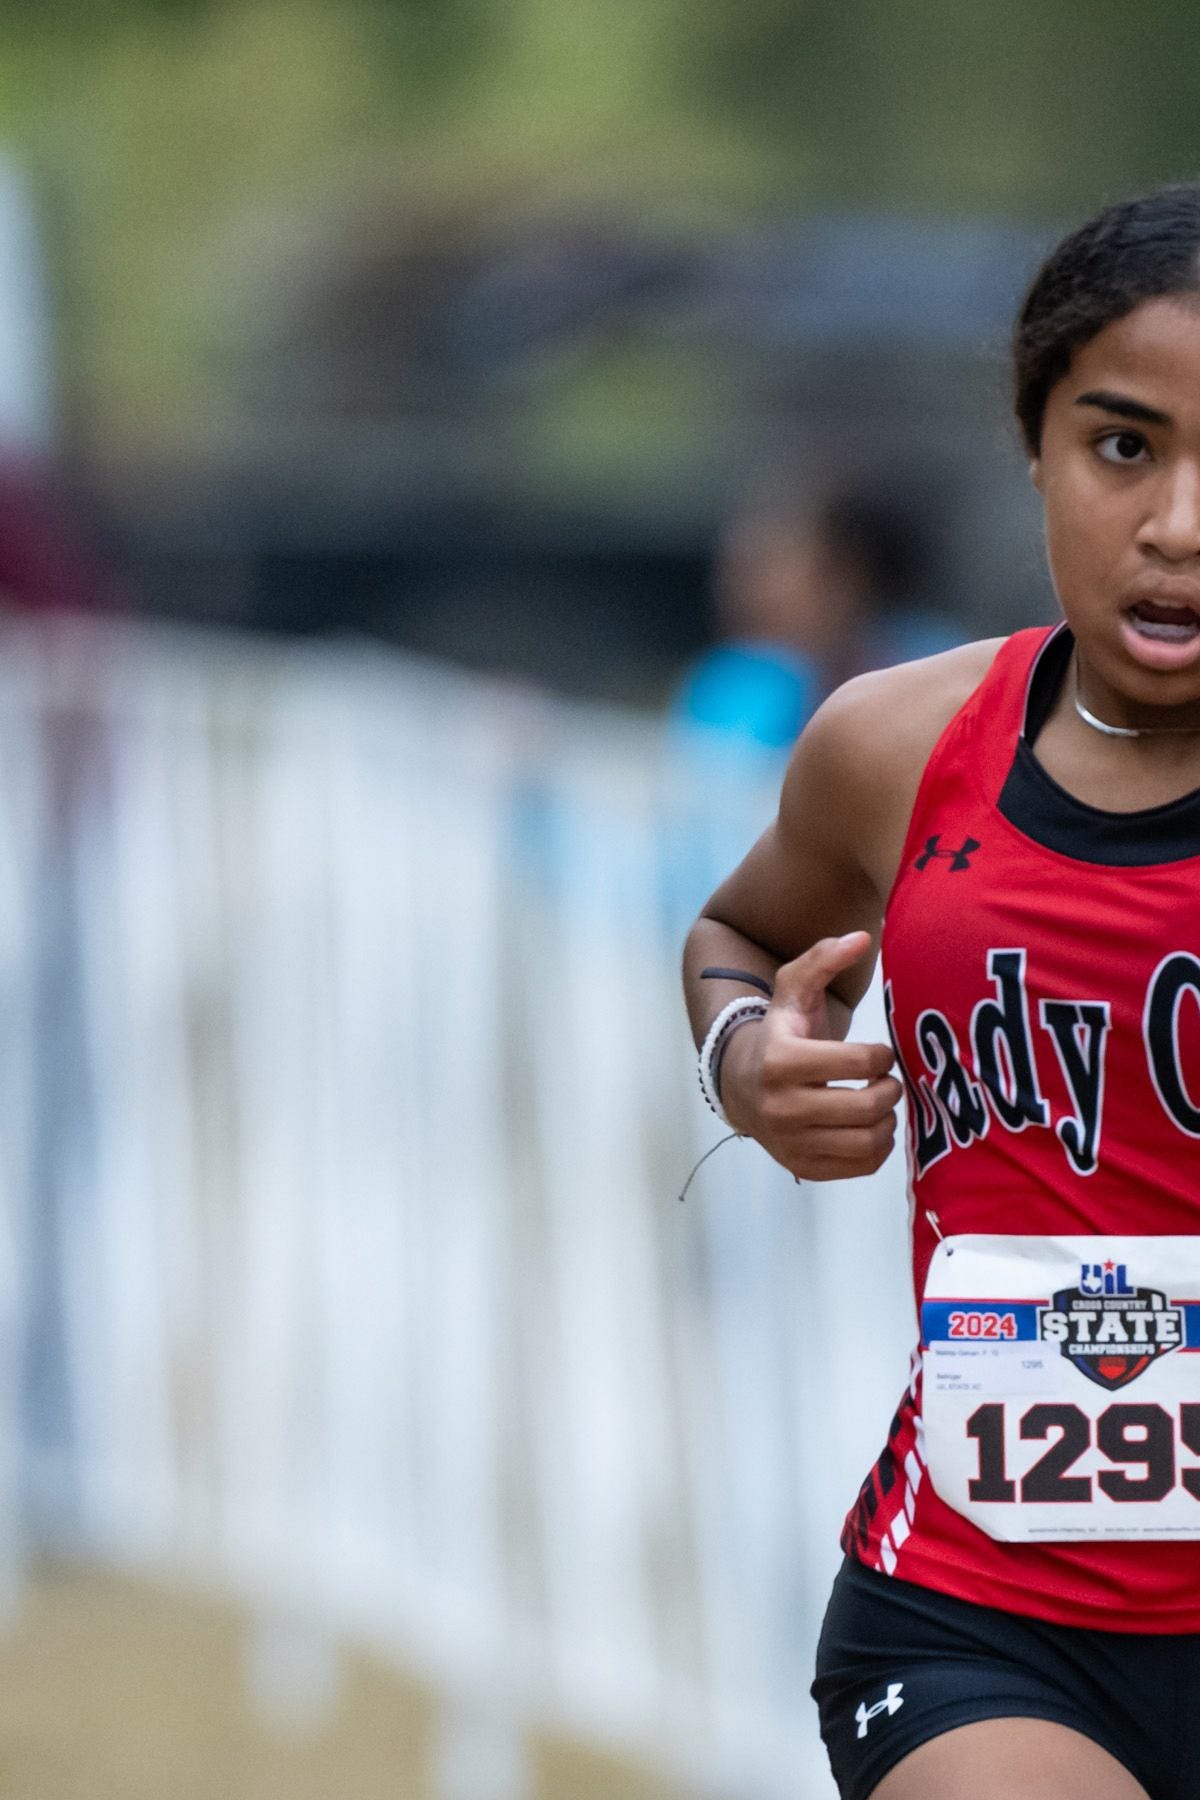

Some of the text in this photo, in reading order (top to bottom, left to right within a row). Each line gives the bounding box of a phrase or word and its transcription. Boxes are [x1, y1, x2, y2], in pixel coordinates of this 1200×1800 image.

[884, 948, 1112, 1181] Lady
[1072, 1299, 1148, 1311] CROSS COUNTRY
[948, 1311, 1017, 1339] 2024
[1042, 1311, 1181, 1343] STATE
[1068, 1343, 1156, 1356] CHAMPIONSHIPS
